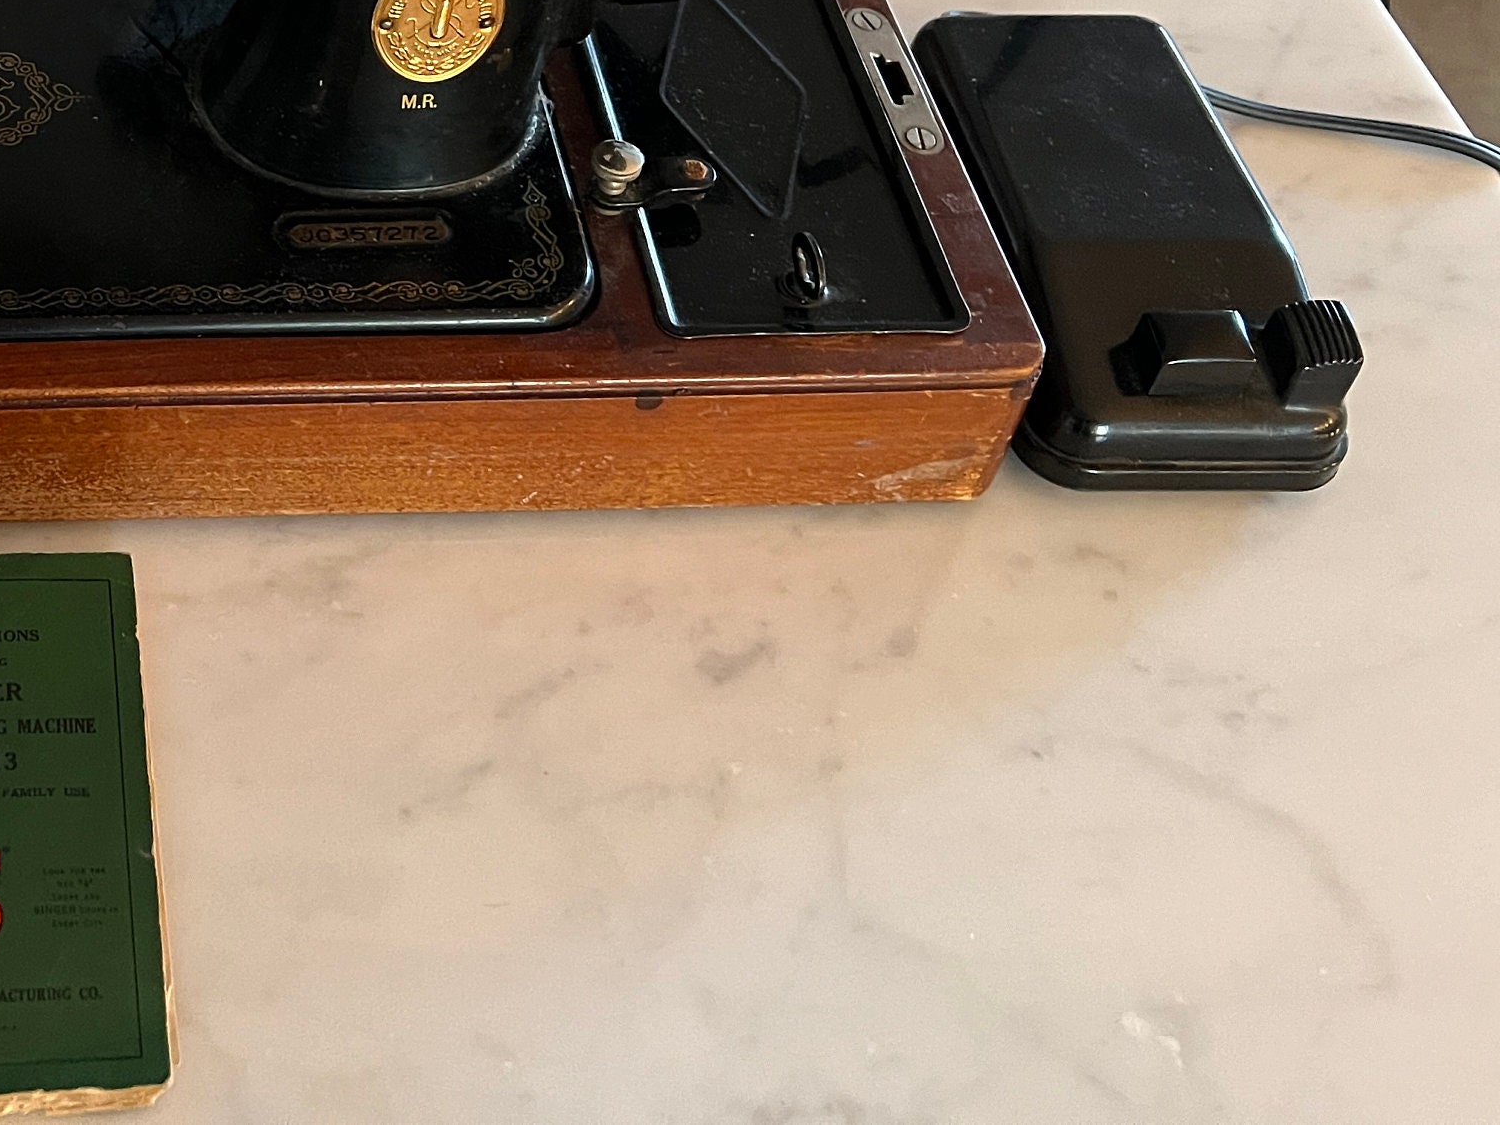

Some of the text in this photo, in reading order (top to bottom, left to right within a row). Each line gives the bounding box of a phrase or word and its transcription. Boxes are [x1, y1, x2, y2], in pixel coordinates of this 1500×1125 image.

[401, 93, 438, 110] M.R.
[17, 717, 97, 735] MACHINE
[2, 787, 56, 798] FAMILY
[64, 786, 91, 798] USE
